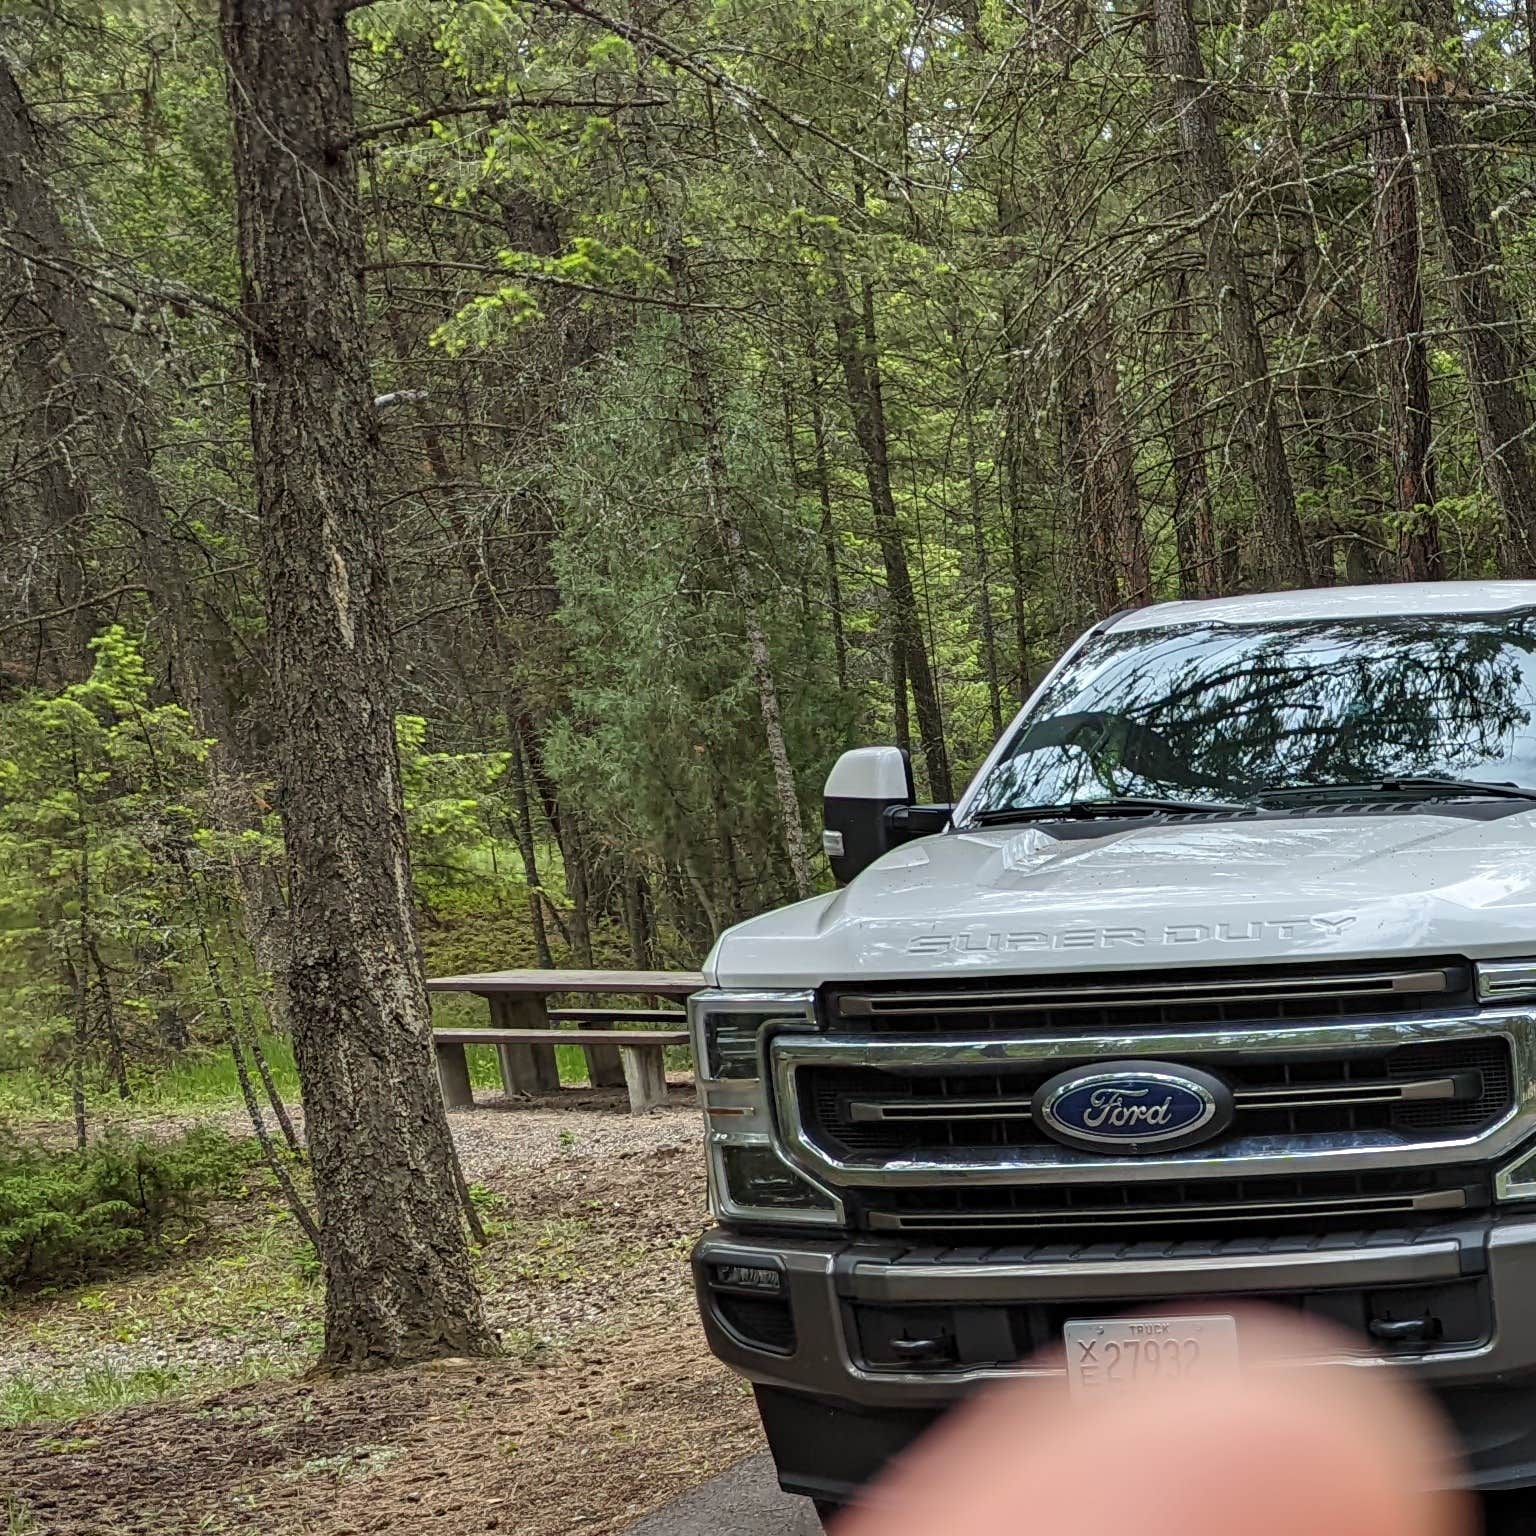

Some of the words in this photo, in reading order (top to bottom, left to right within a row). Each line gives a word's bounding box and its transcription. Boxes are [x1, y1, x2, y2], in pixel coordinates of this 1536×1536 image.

[905, 927, 1146, 955] SUPER
[1160, 915, 1358, 946] DUTY
[1083, 1088, 1173, 1128] Ford
[1128, 1323, 1171, 1336] TRUCK
